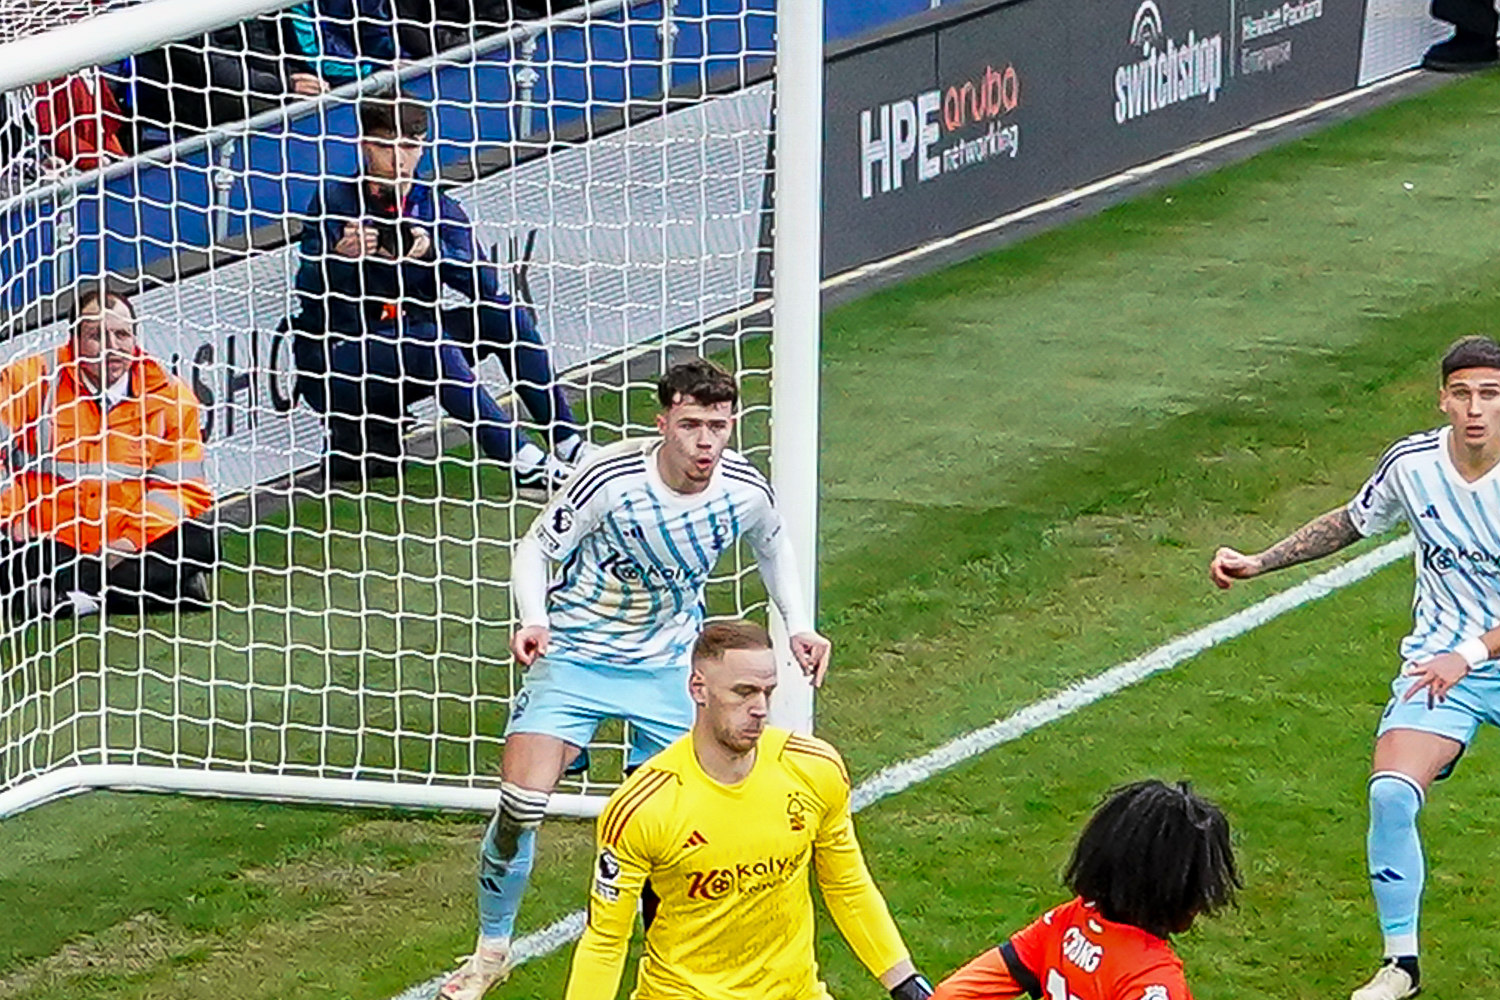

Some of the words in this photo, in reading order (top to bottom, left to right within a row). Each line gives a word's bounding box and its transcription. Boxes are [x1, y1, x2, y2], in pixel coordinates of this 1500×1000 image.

[944, 64, 1018, 131] aruba
[1114, 29, 1222, 124] switchshop
[860, 90, 941, 199] HPE
[943, 120, 1019, 172] networking
